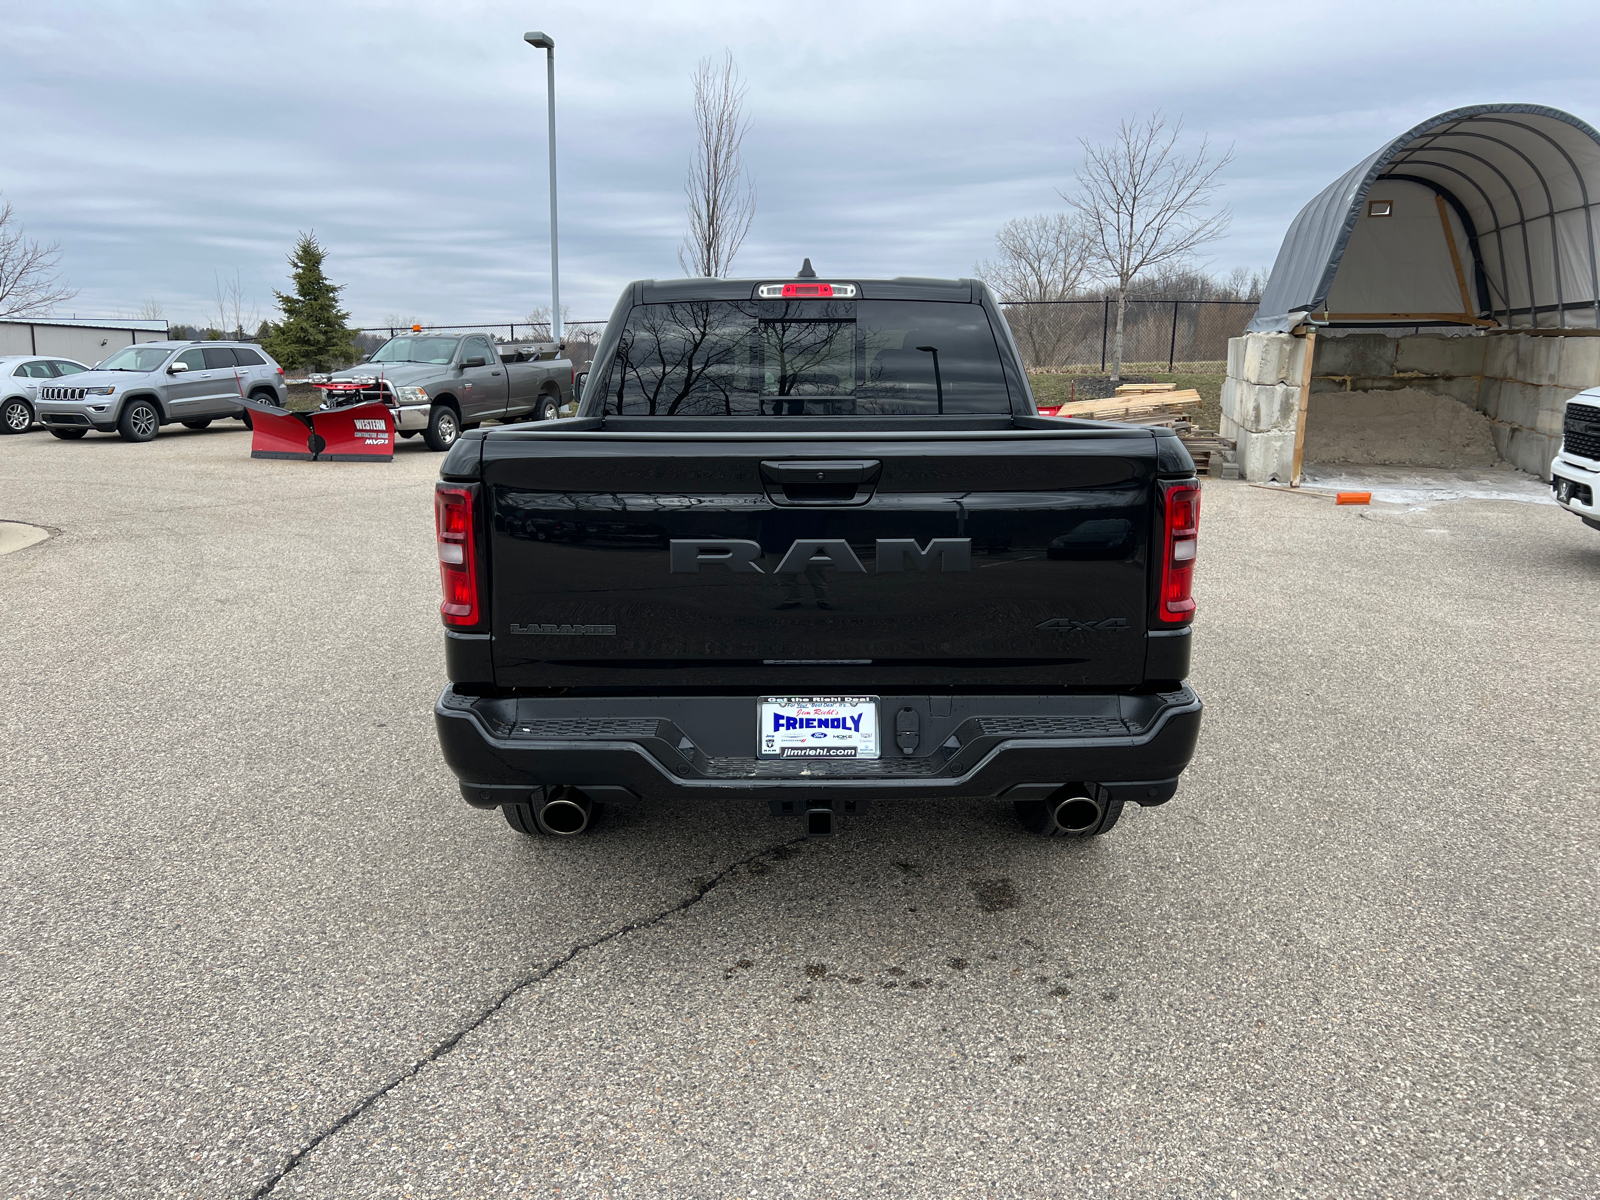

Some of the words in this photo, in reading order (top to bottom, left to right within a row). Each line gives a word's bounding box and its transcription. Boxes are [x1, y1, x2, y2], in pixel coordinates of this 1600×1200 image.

[353, 419, 386, 430] WESTERN
[669, 538, 972, 574] RAM
[510, 623, 617, 636] LARAMIE
[796, 708, 811, 717] Jim
[813, 708, 839, 716] Riehl's
[773, 712, 863, 733] FRIENDLY
[783, 748, 856, 757] jimriehl.com
